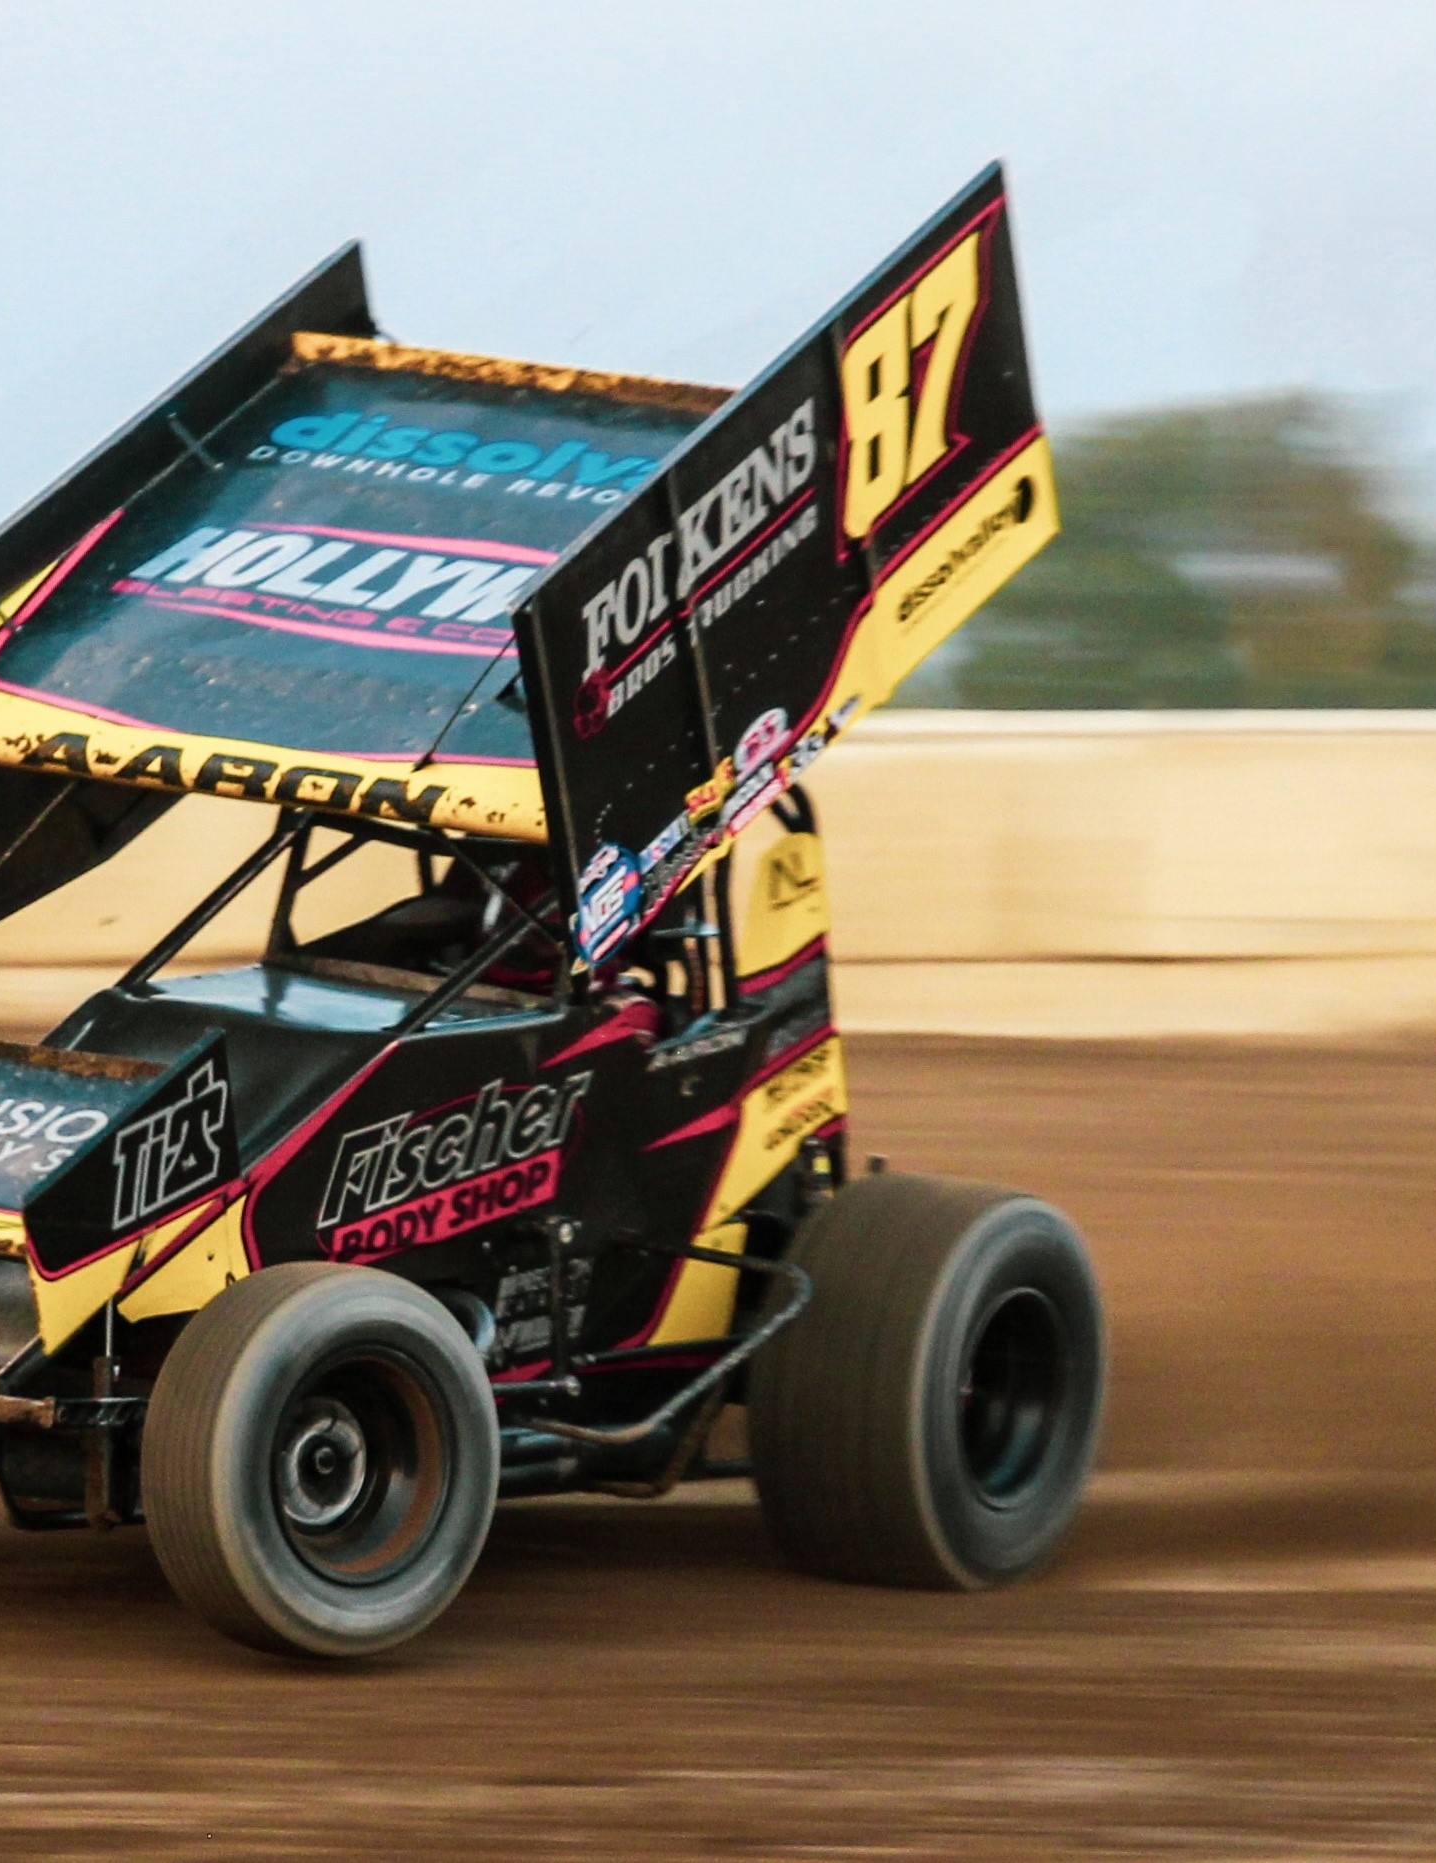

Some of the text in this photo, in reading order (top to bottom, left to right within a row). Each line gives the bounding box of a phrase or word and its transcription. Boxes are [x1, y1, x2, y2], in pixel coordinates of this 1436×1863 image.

[841, 230, 982, 540] 87
[247, 445, 629, 505] DOWNHOLE REVO
[110, 577, 378, 630] BLASTING
[130, 526, 546, 624] HOLLYW
[607, 633, 678, 719] BROS
[316, 1069, 594, 1230] Fischer
[336, 1161, 551, 1258] BODY SHOP
